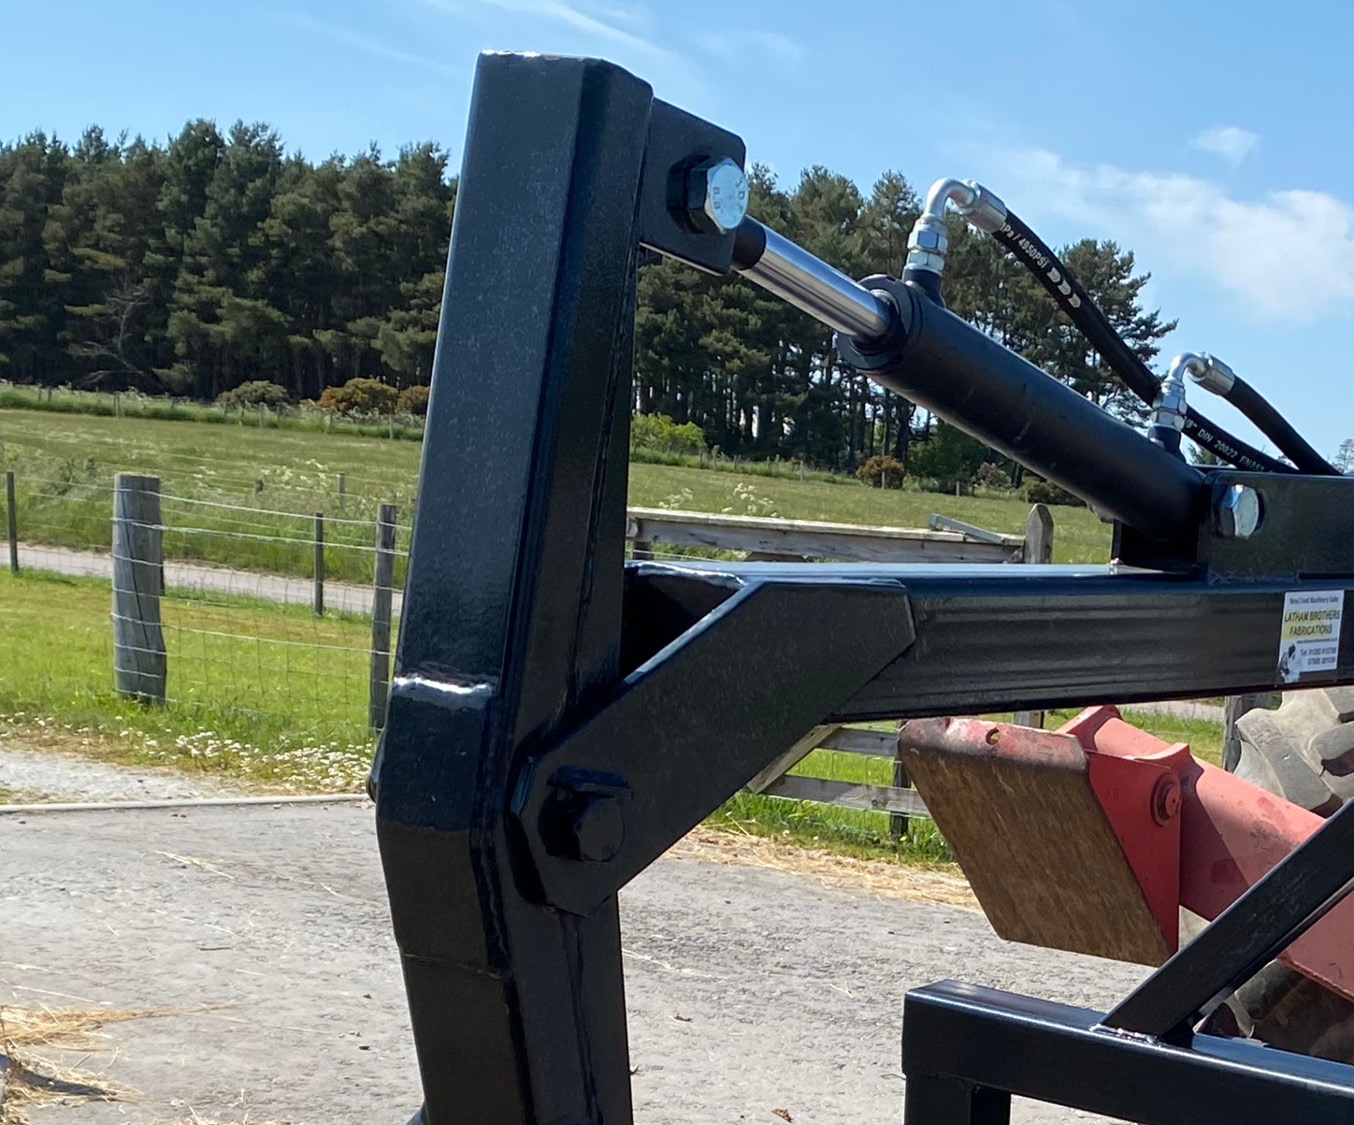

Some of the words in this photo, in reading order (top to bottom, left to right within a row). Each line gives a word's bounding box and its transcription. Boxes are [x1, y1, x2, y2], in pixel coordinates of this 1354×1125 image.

[1018, 238, 1049, 268] 4950PSI
[1197, 428, 1214, 442] DIN
[1213, 440, 1238, 458] 20022
[1284, 611, 1309, 622] LATHAM
[1309, 609, 1340, 620] BROTHERS
[1289, 624, 1332, 636] FABRICATIONS
